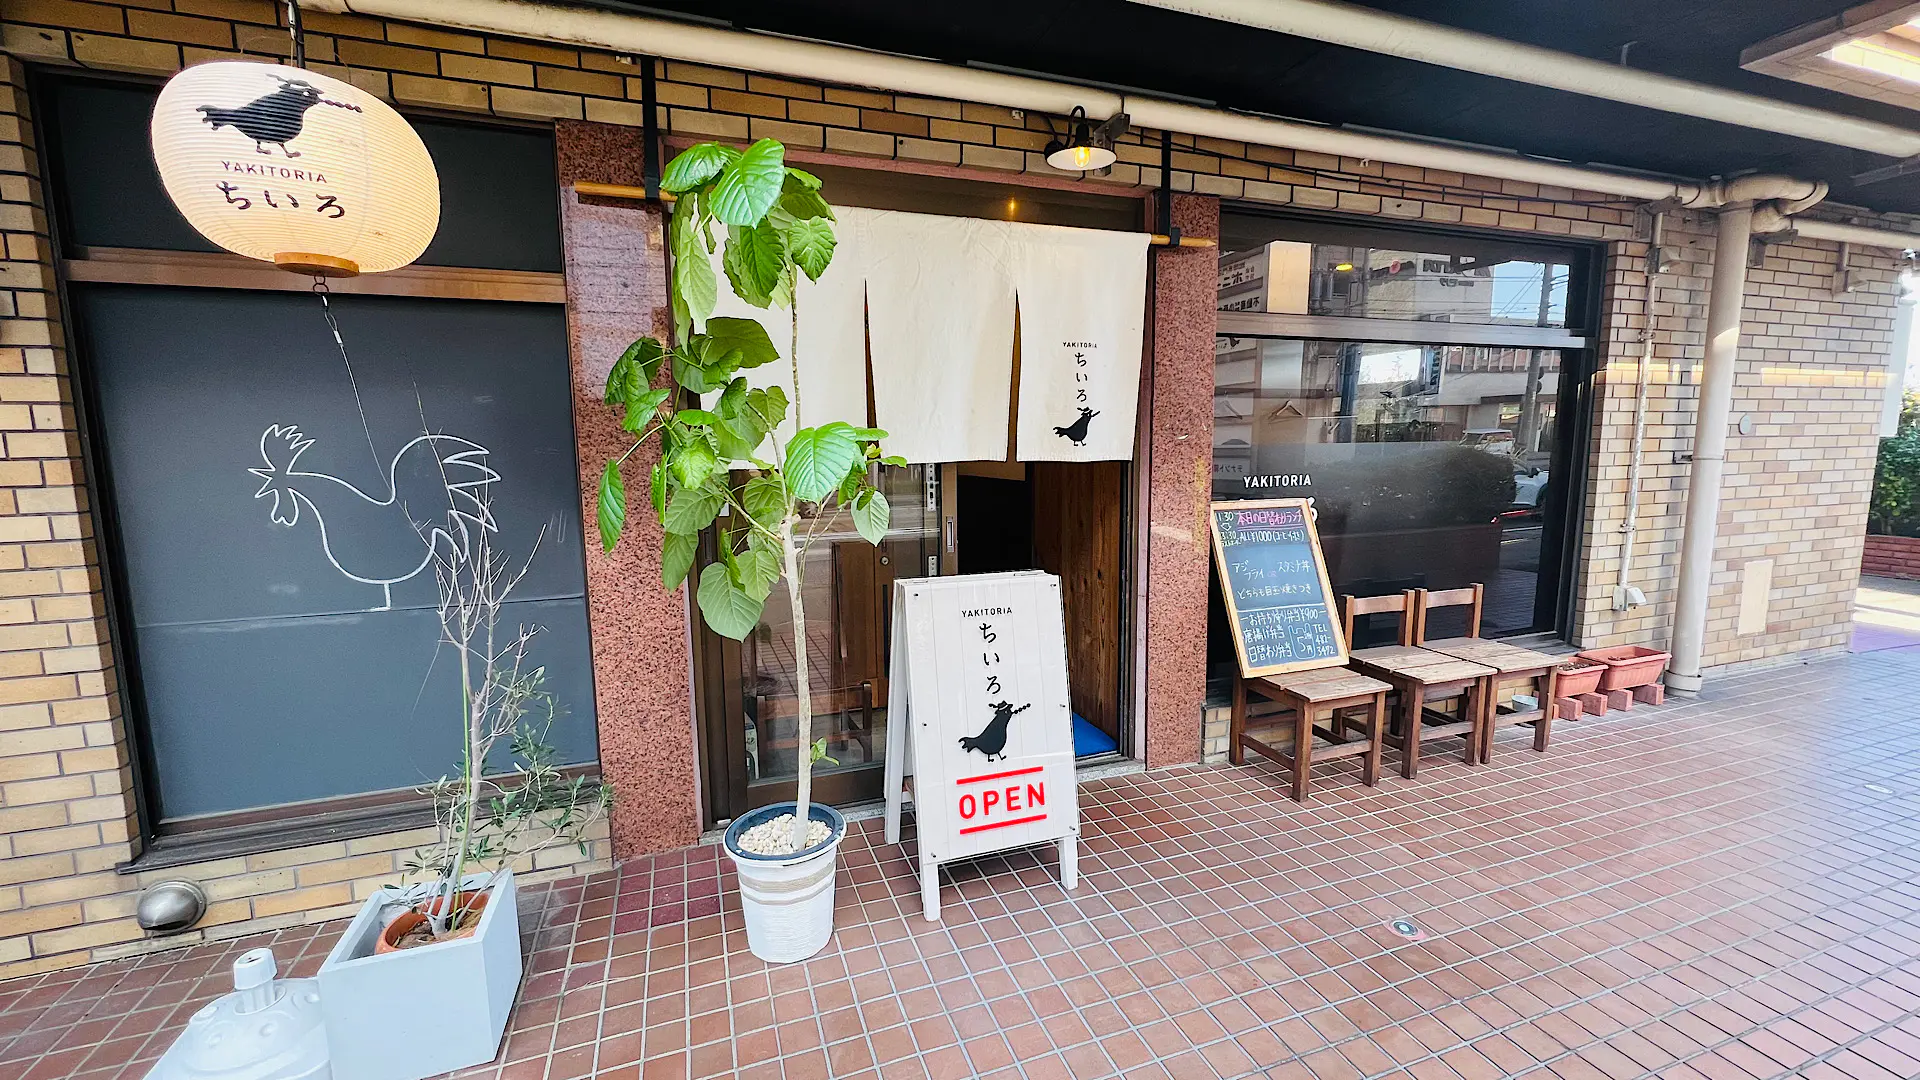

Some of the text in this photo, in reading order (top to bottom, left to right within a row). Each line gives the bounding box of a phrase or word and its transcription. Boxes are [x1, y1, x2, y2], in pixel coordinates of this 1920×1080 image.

[221, 160, 327, 183] YAKITORIA
[216, 181, 345, 218] ちいろ
[1062, 341, 1098, 349] YAKITORIA
[1074, 352, 1089, 403] ちいろ
[1243, 474, 1312, 488] YAKITORIA
[961, 607, 1013, 618] YAKITORIA
[1312, 623, 1328, 634] TEL
[979, 622, 1001, 695] ちいろ
[959, 781, 1046, 820] OPEN
